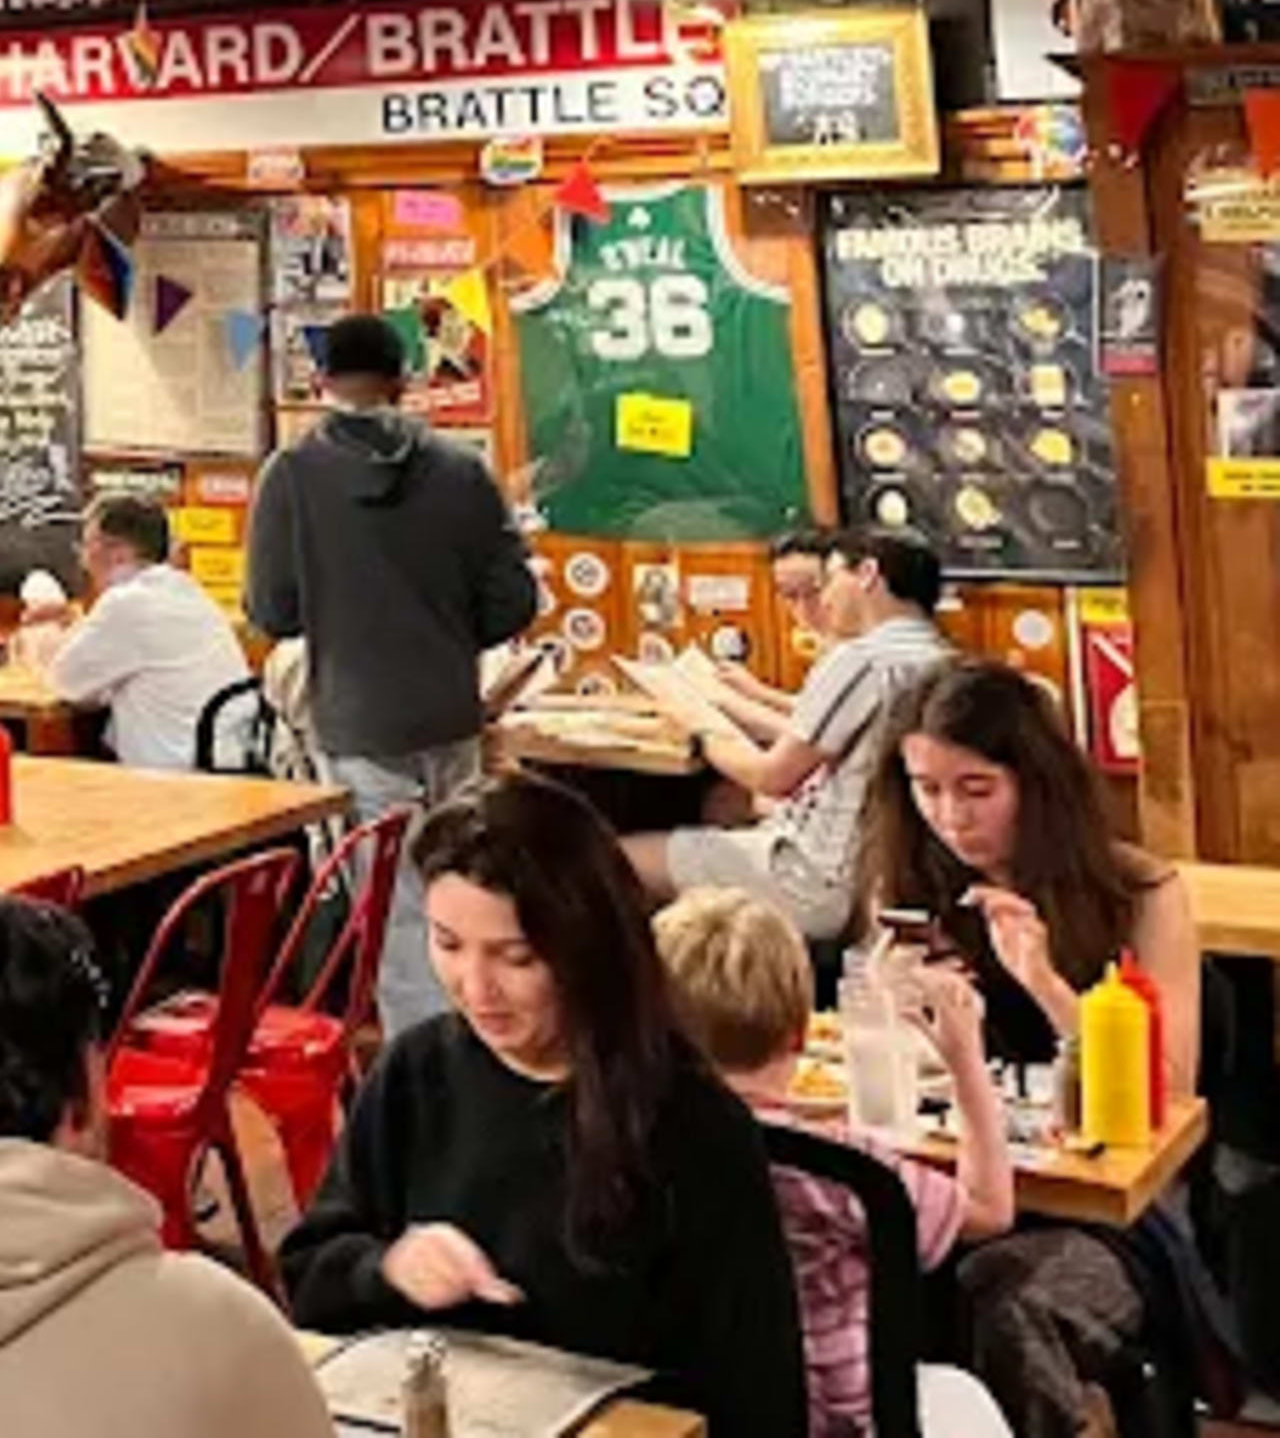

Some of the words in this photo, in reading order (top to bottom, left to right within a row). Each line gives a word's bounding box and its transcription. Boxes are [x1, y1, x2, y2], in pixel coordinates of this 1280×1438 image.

[381, 79, 618, 134] BRATTLE
[643, 74, 727, 119] SQ
[587, 272, 715, 362] 36
